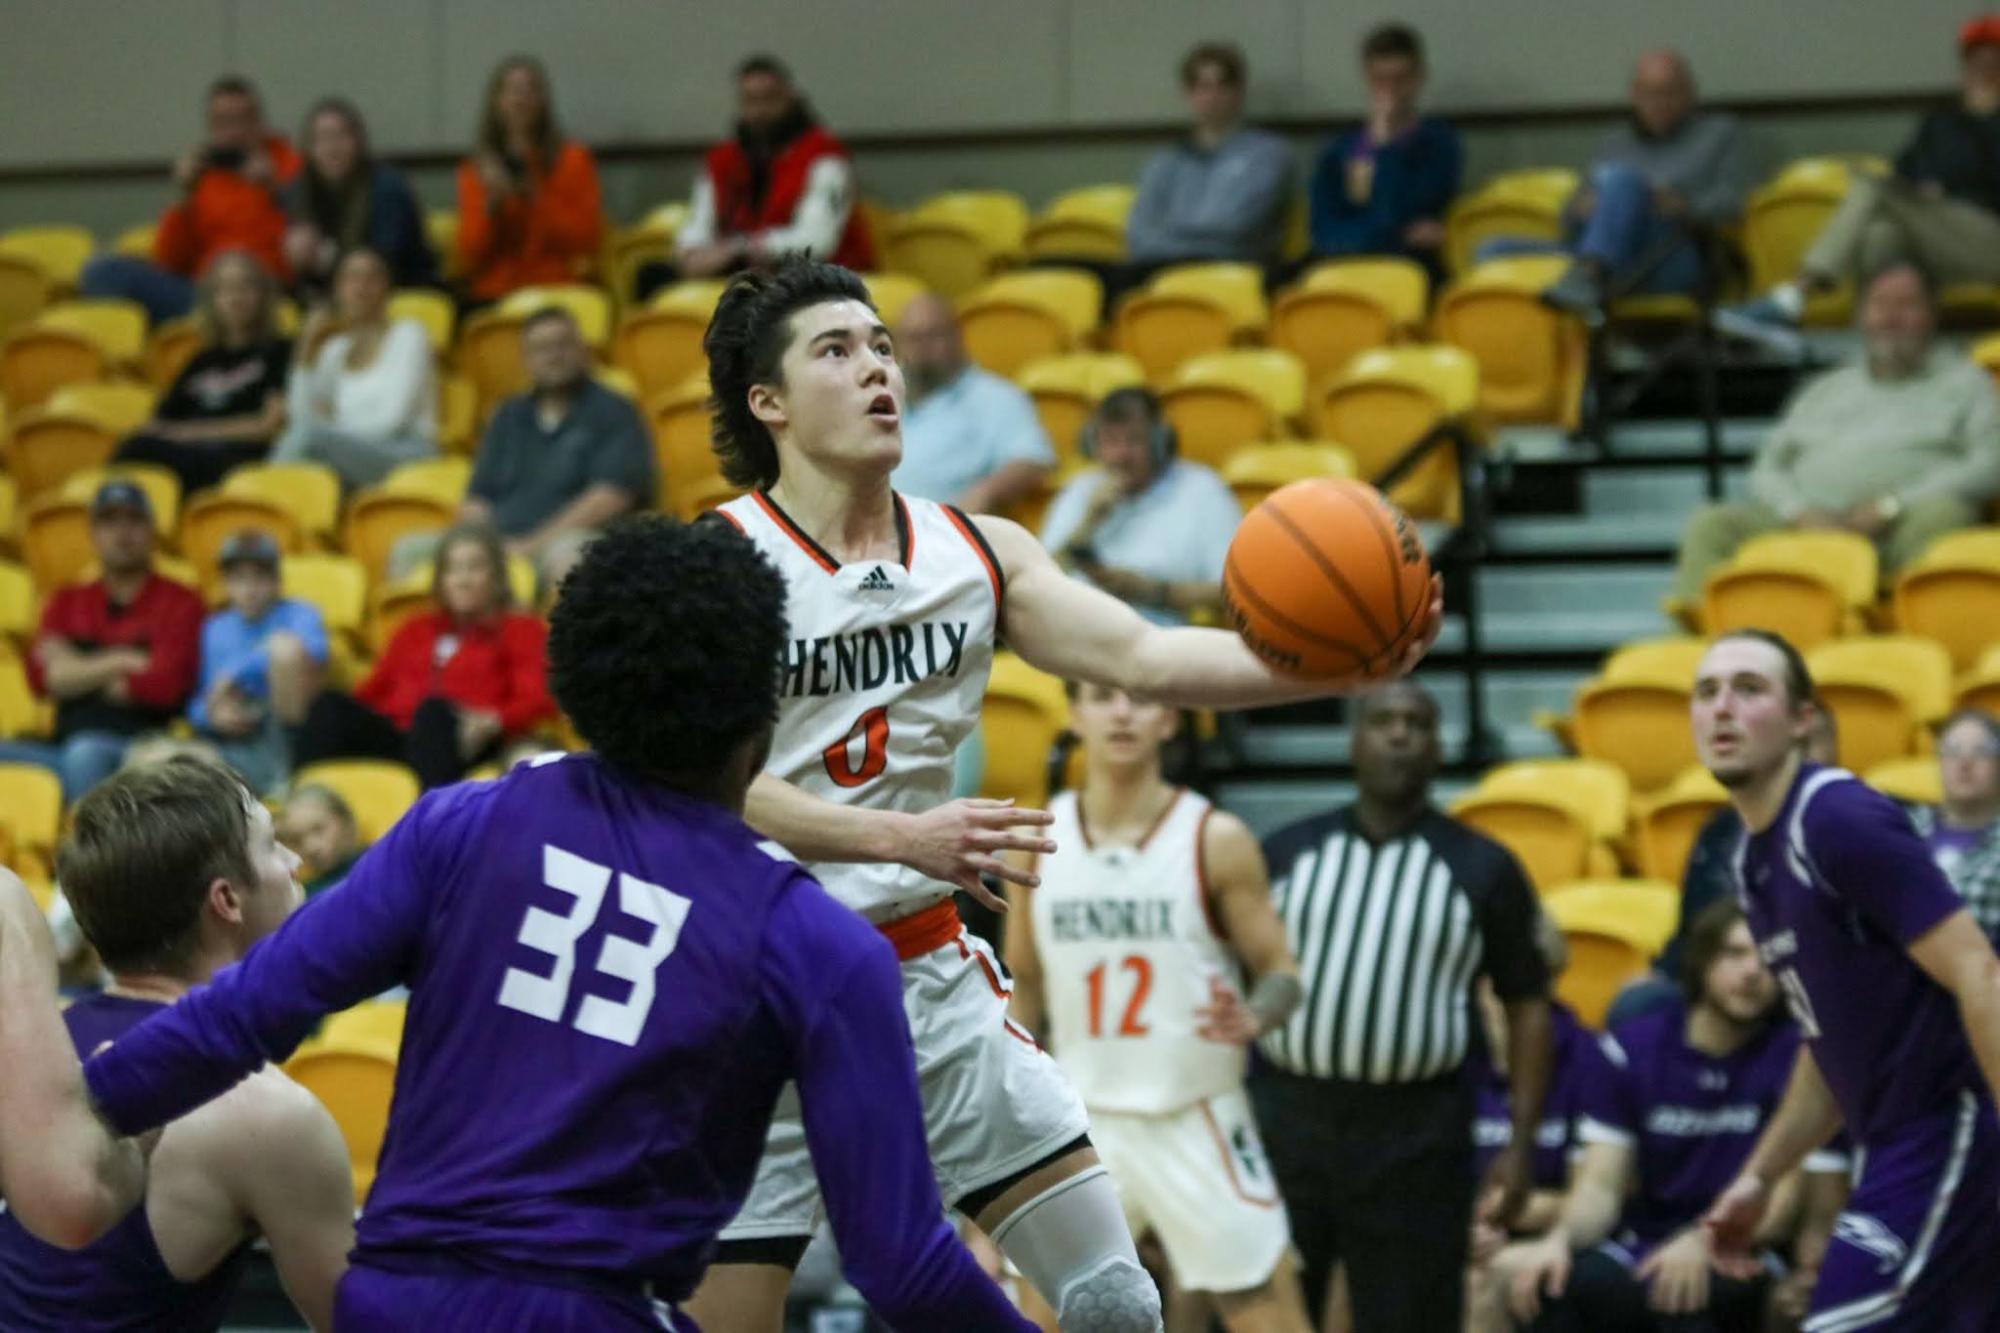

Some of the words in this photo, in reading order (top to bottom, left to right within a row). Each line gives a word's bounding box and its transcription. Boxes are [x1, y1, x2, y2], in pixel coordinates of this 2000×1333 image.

[858, 580, 895, 591] adidas
[779, 622, 968, 698] HENDRIX
[823, 706, 889, 788] 0
[497, 843, 693, 1047] 33
[1085, 955, 1153, 1038] 12
